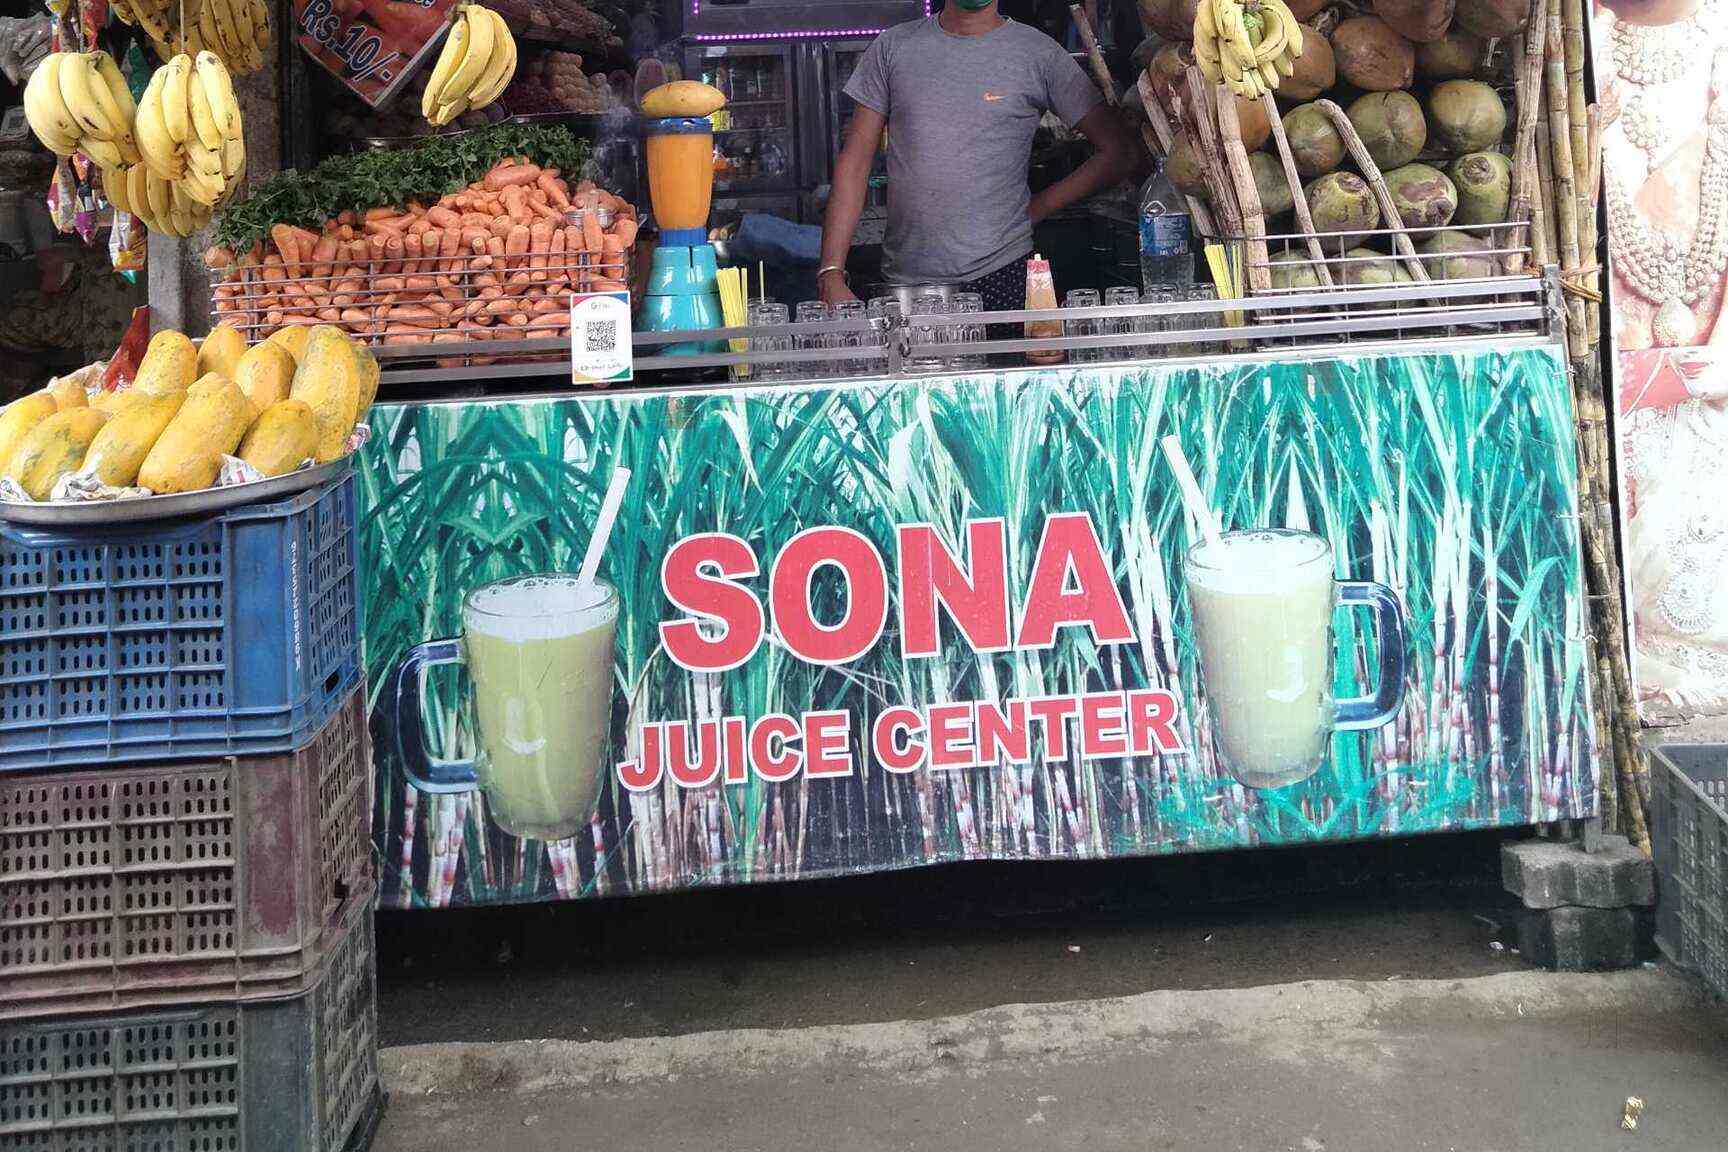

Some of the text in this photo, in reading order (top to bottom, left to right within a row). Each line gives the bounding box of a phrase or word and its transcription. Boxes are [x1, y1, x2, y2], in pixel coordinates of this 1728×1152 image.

[658, 511, 1136, 673] SONA
[616, 689, 1187, 791] JUICE CENTER
